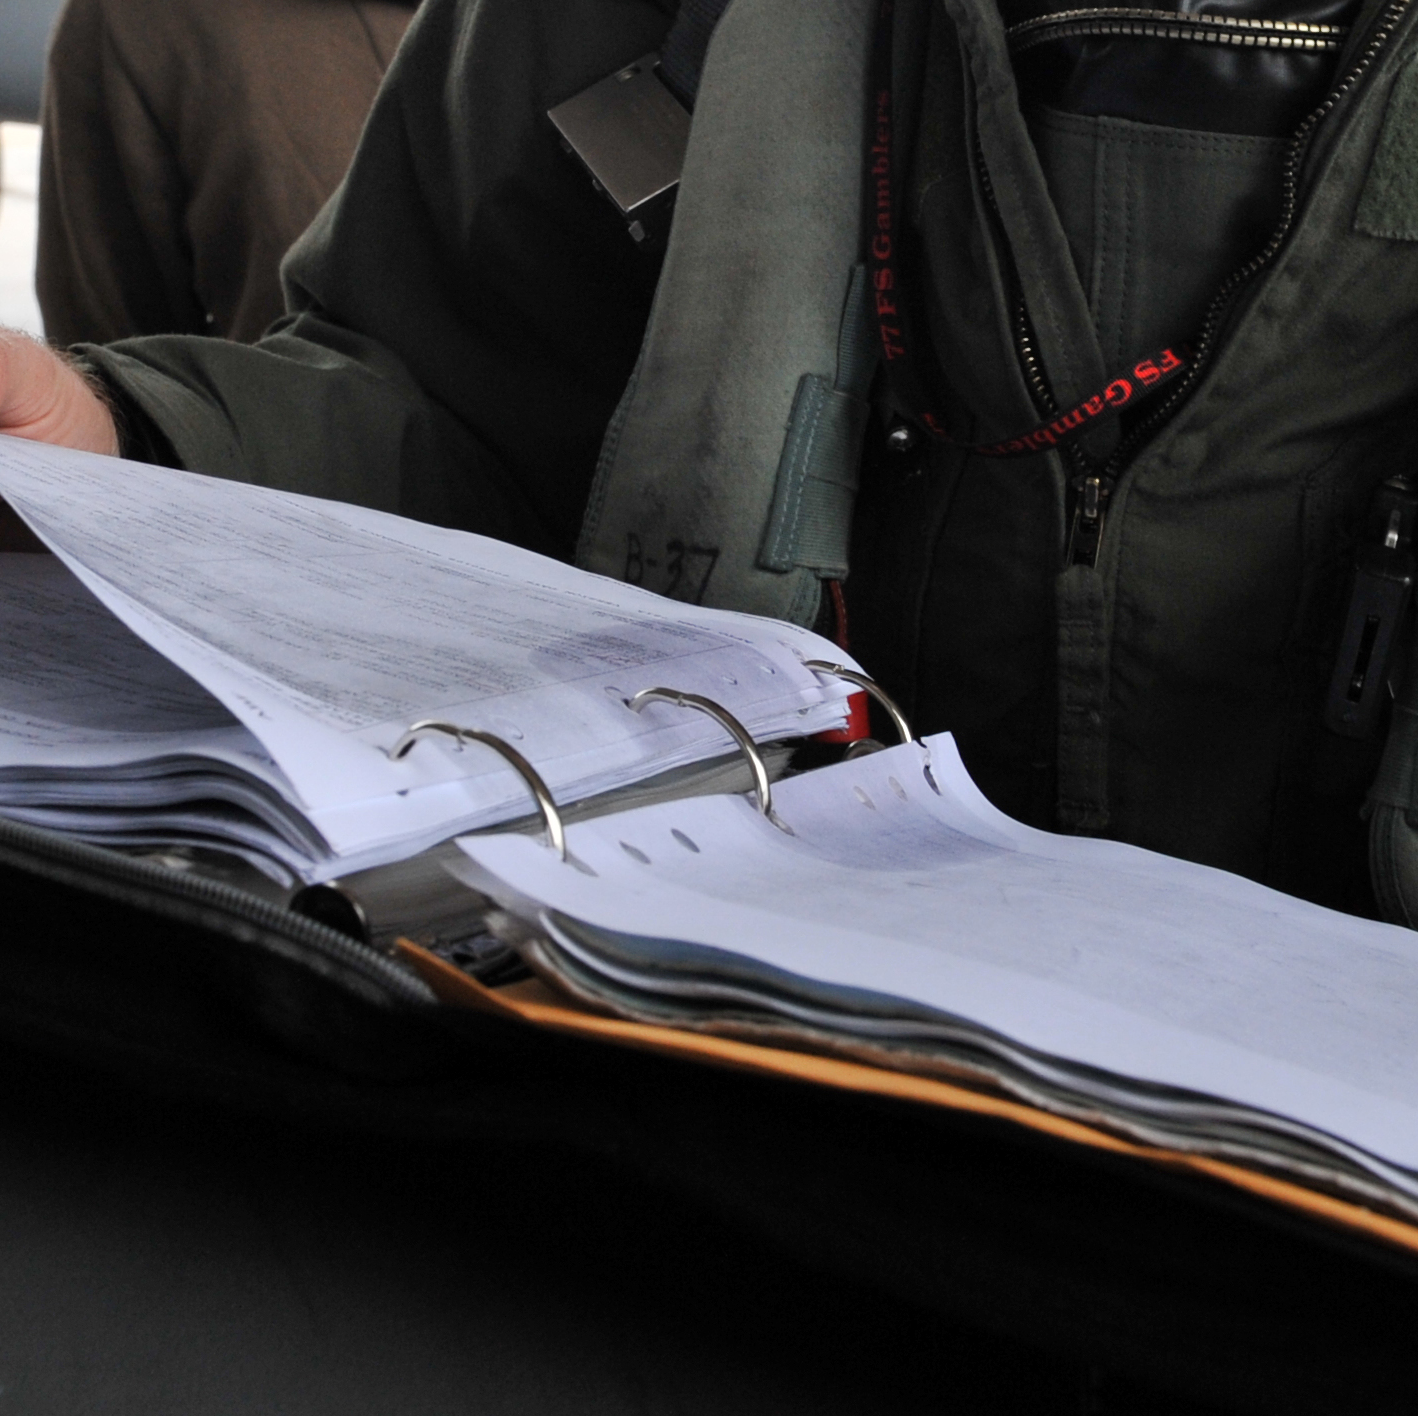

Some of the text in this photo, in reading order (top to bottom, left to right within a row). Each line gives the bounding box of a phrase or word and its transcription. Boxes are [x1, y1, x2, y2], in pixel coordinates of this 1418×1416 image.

[871, 89, 906, 361] 77 FS Gamblers
[1133, 346, 1183, 389] FS
